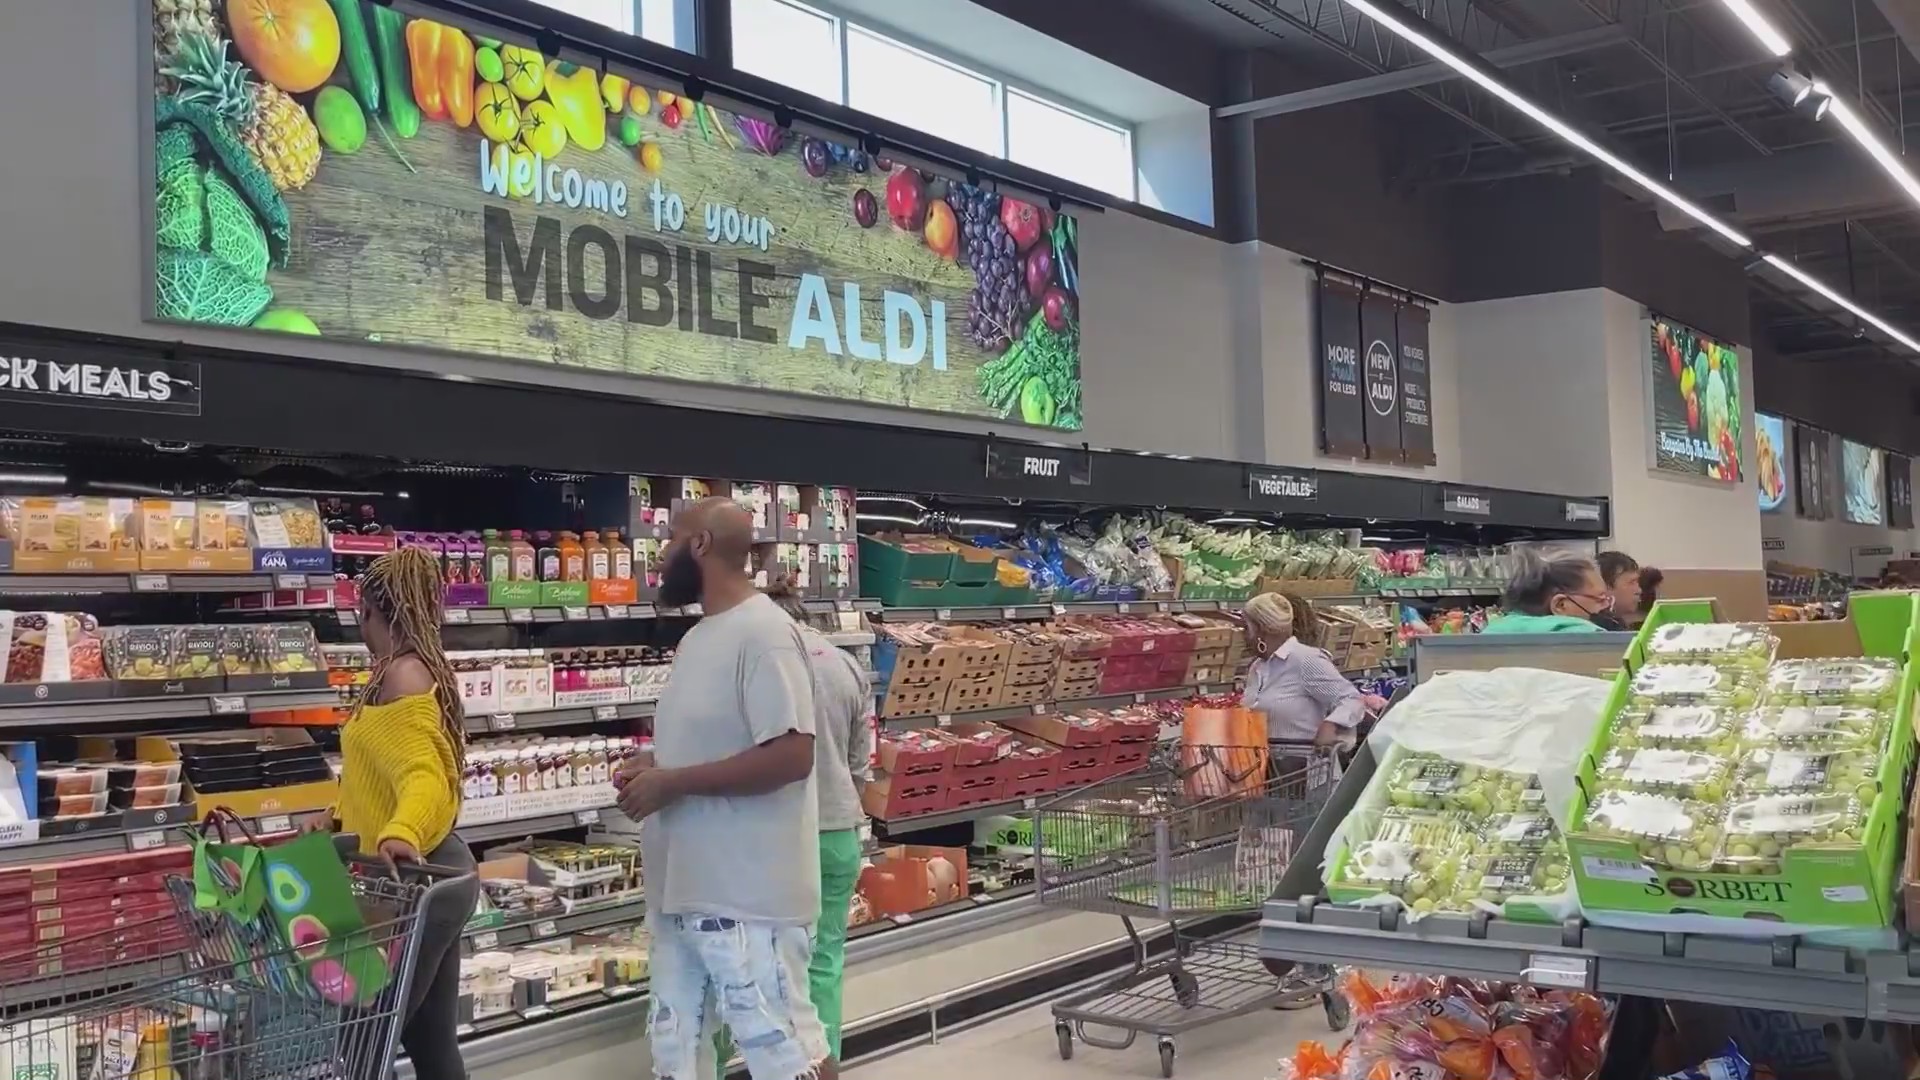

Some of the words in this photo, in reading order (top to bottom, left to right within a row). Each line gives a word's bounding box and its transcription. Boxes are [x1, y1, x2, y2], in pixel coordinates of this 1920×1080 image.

[480, 138, 628, 218] Welcome
[649, 178, 684, 232] to
[705, 200, 776, 252] your
[484, 205, 777, 344] MOBILE
[787, 273, 947, 370] ALDI
[1328, 344, 1355, 365] MORE
[1371, 353, 1391, 371] NEW
[49, 361, 171, 401] MEALS
[1329, 380, 1341, 393] FOR
[1342, 383, 1356, 395] LESS
[1372, 383, 1392, 400] ALDI
[1023, 457, 1060, 477] FRUIT
[1258, 479, 1311, 498] VEGETABLES
[1456, 495, 1480, 510] SALADS
[261, 556, 287, 568] RANA
[188, 640, 215, 649] RAVIOLI
[1644, 876, 1792, 903] SORBET
